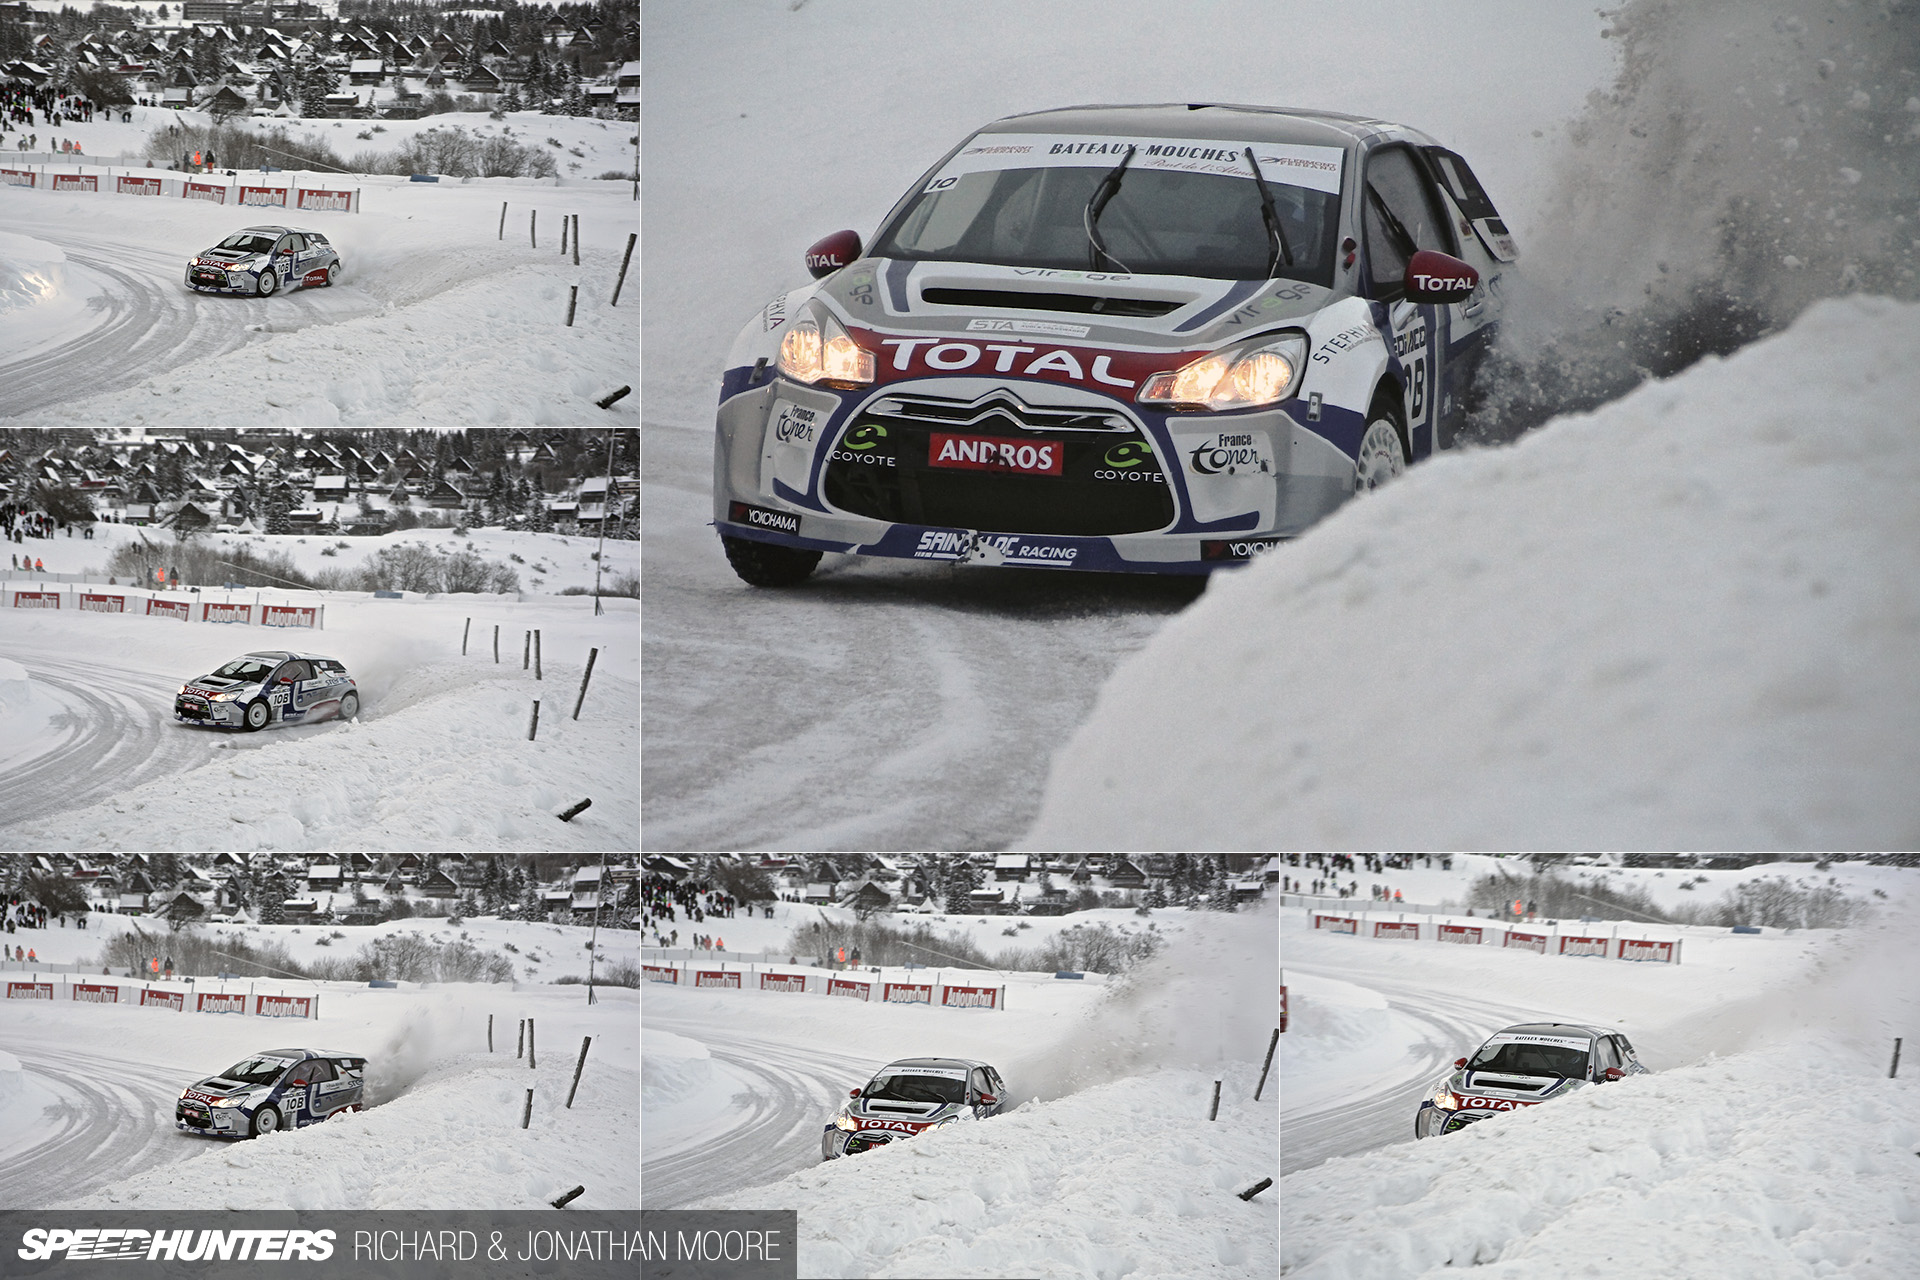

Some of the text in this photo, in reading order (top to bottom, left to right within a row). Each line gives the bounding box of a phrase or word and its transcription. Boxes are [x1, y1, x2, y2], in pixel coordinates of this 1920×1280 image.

[928, 176, 958, 191] 10
[198, 258, 227, 269] TOTAL
[805, 253, 844, 269] OTAL
[1412, 274, 1475, 291] TOTAL
[973, 320, 1015, 331] STA
[881, 337, 1136, 388] TOTAL
[790, 404, 816, 422] France
[1218, 433, 1252, 447] France
[831, 449, 897, 468] COYOTE
[937, 438, 1053, 472] ANDROS
[1188, 439, 1259, 475] toner
[1093, 469, 1163, 483] COYOTE
[747, 508, 798, 532] YOKOHAMA
[1018, 545, 1078, 560] RACING
[183, 686, 212, 698] TOTAL
[273, 693, 289, 705] 10B
[185, 1090, 213, 1104] TOTAL
[285, 1097, 304, 1111] 10B
[859, 1119, 919, 1133] TOTAL
